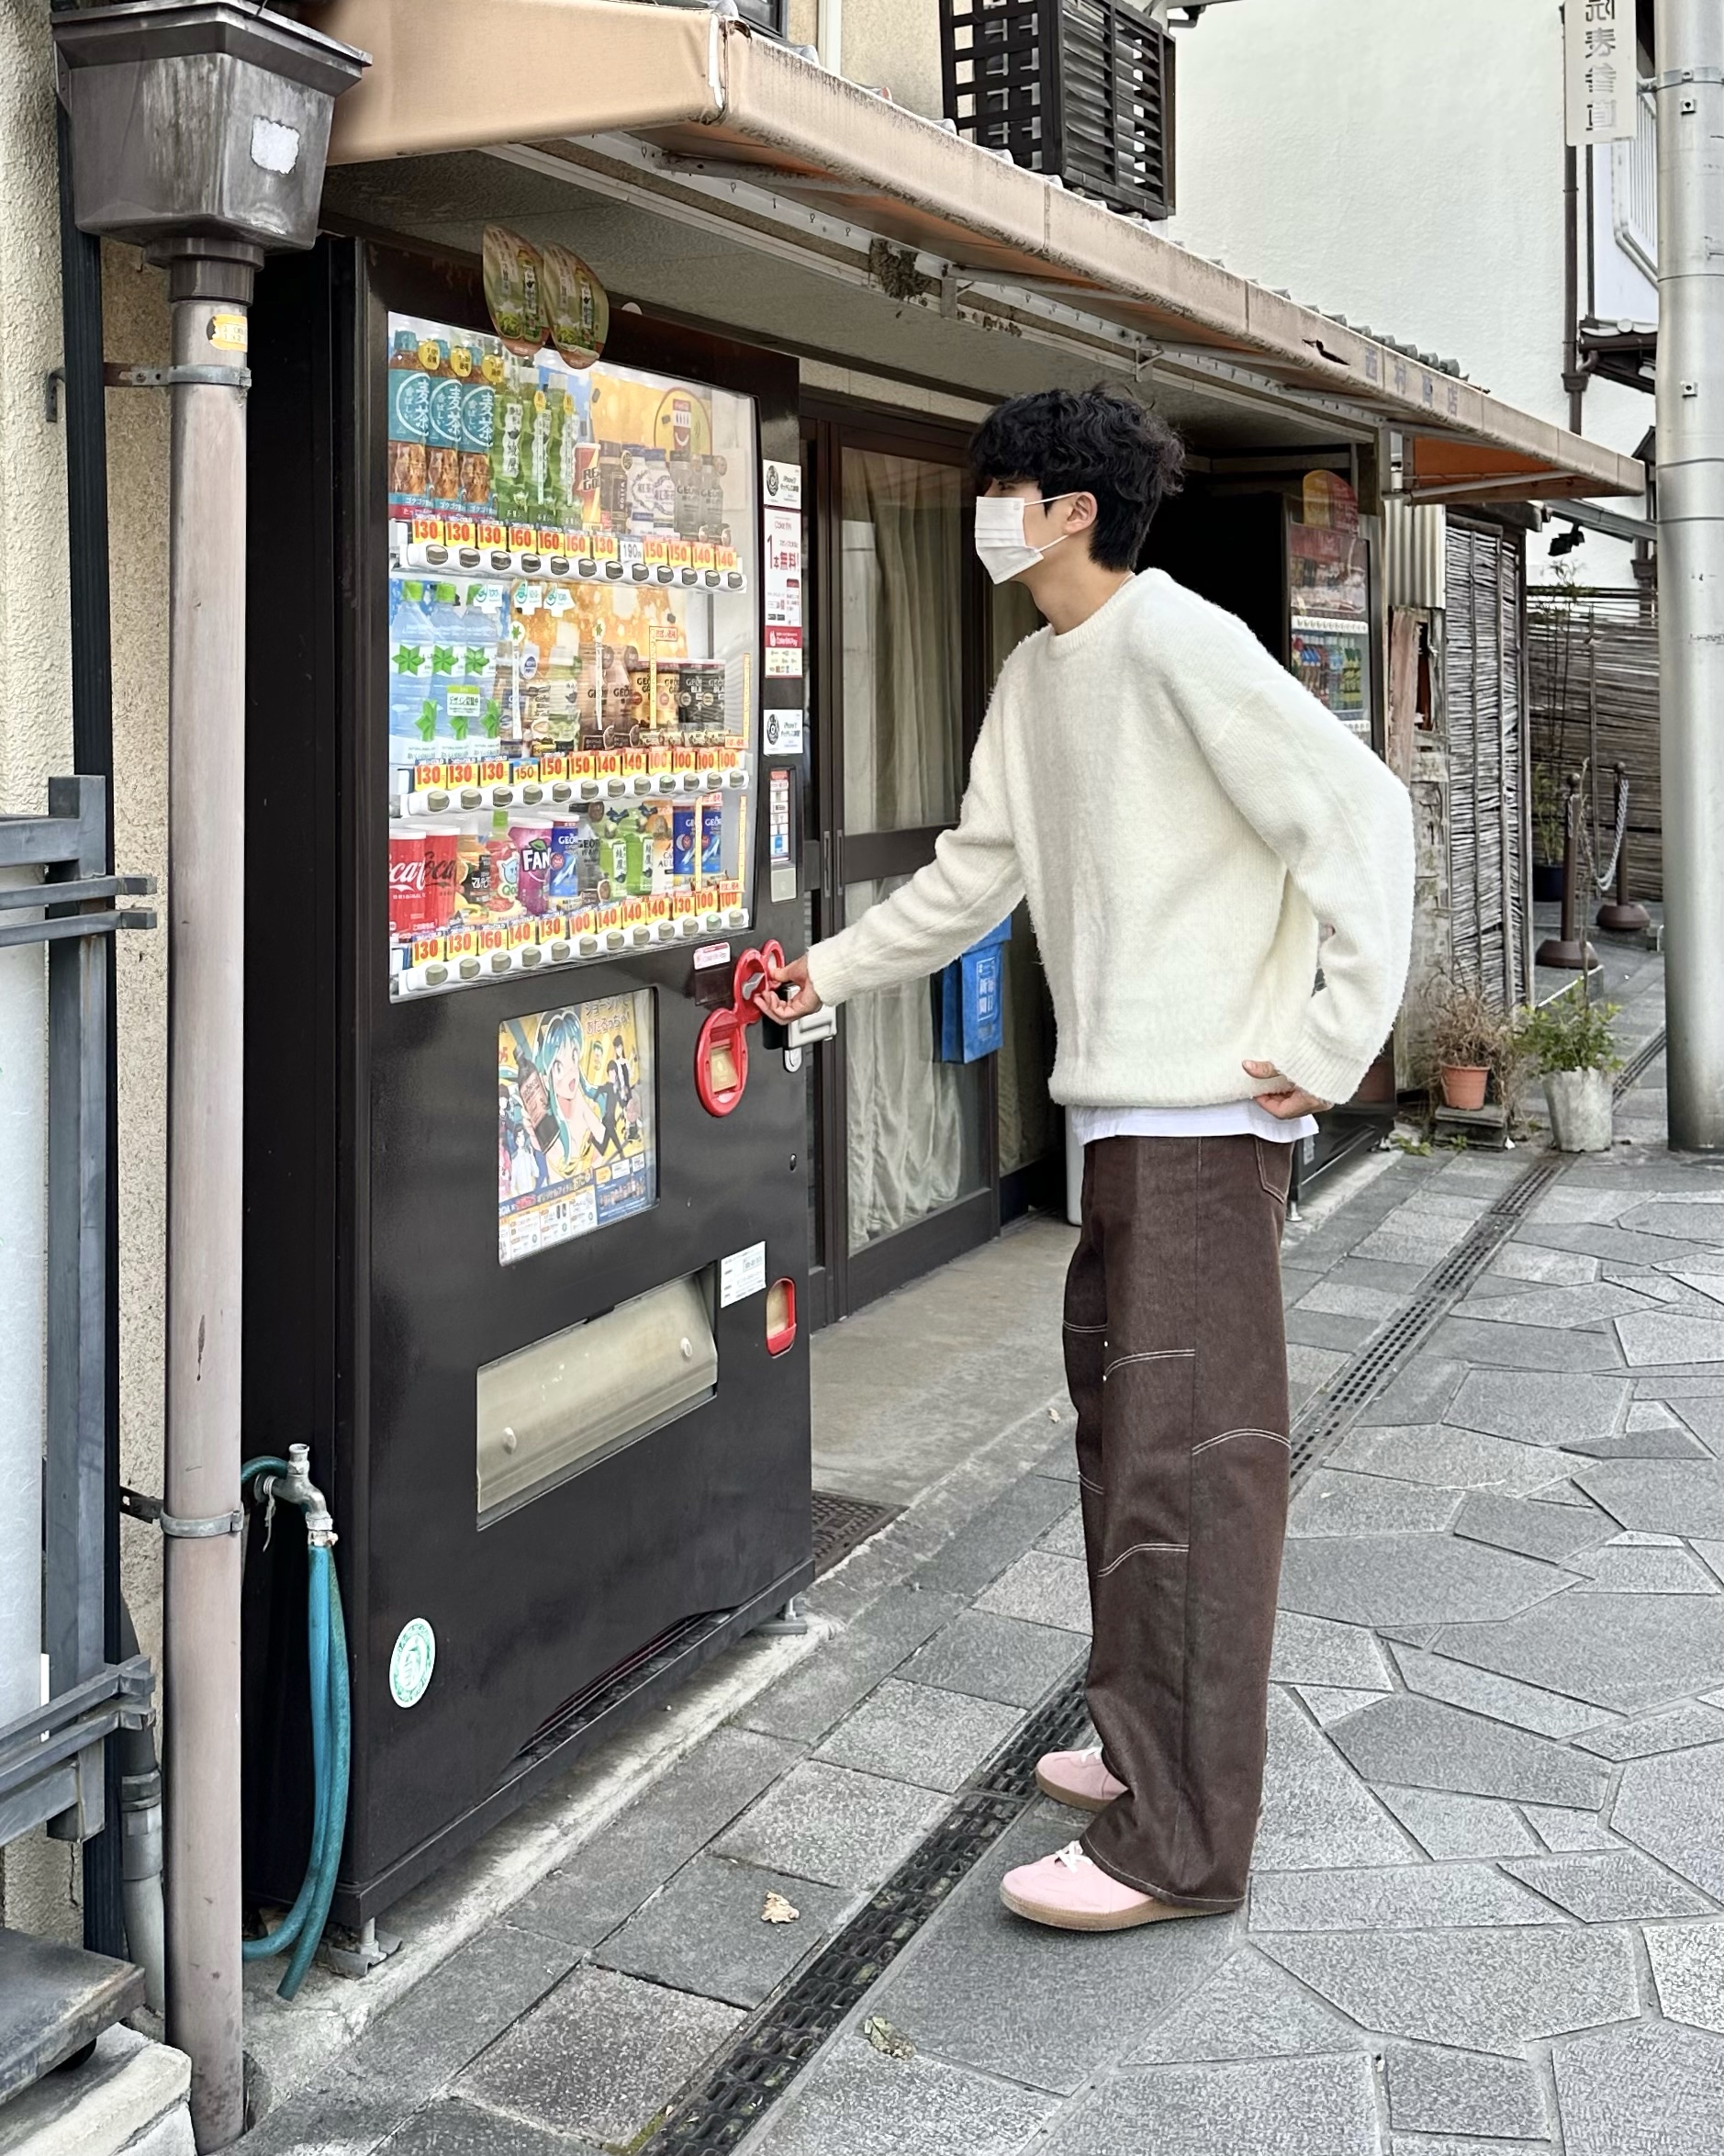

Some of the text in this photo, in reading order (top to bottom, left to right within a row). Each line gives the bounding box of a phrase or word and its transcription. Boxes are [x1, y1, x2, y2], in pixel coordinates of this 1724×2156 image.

[415, 379, 430, 430] 麦茶
[446, 386, 462, 436] 麦茶
[477, 393, 494, 441] 麦茶
[522, 843, 552, 872] FAN
